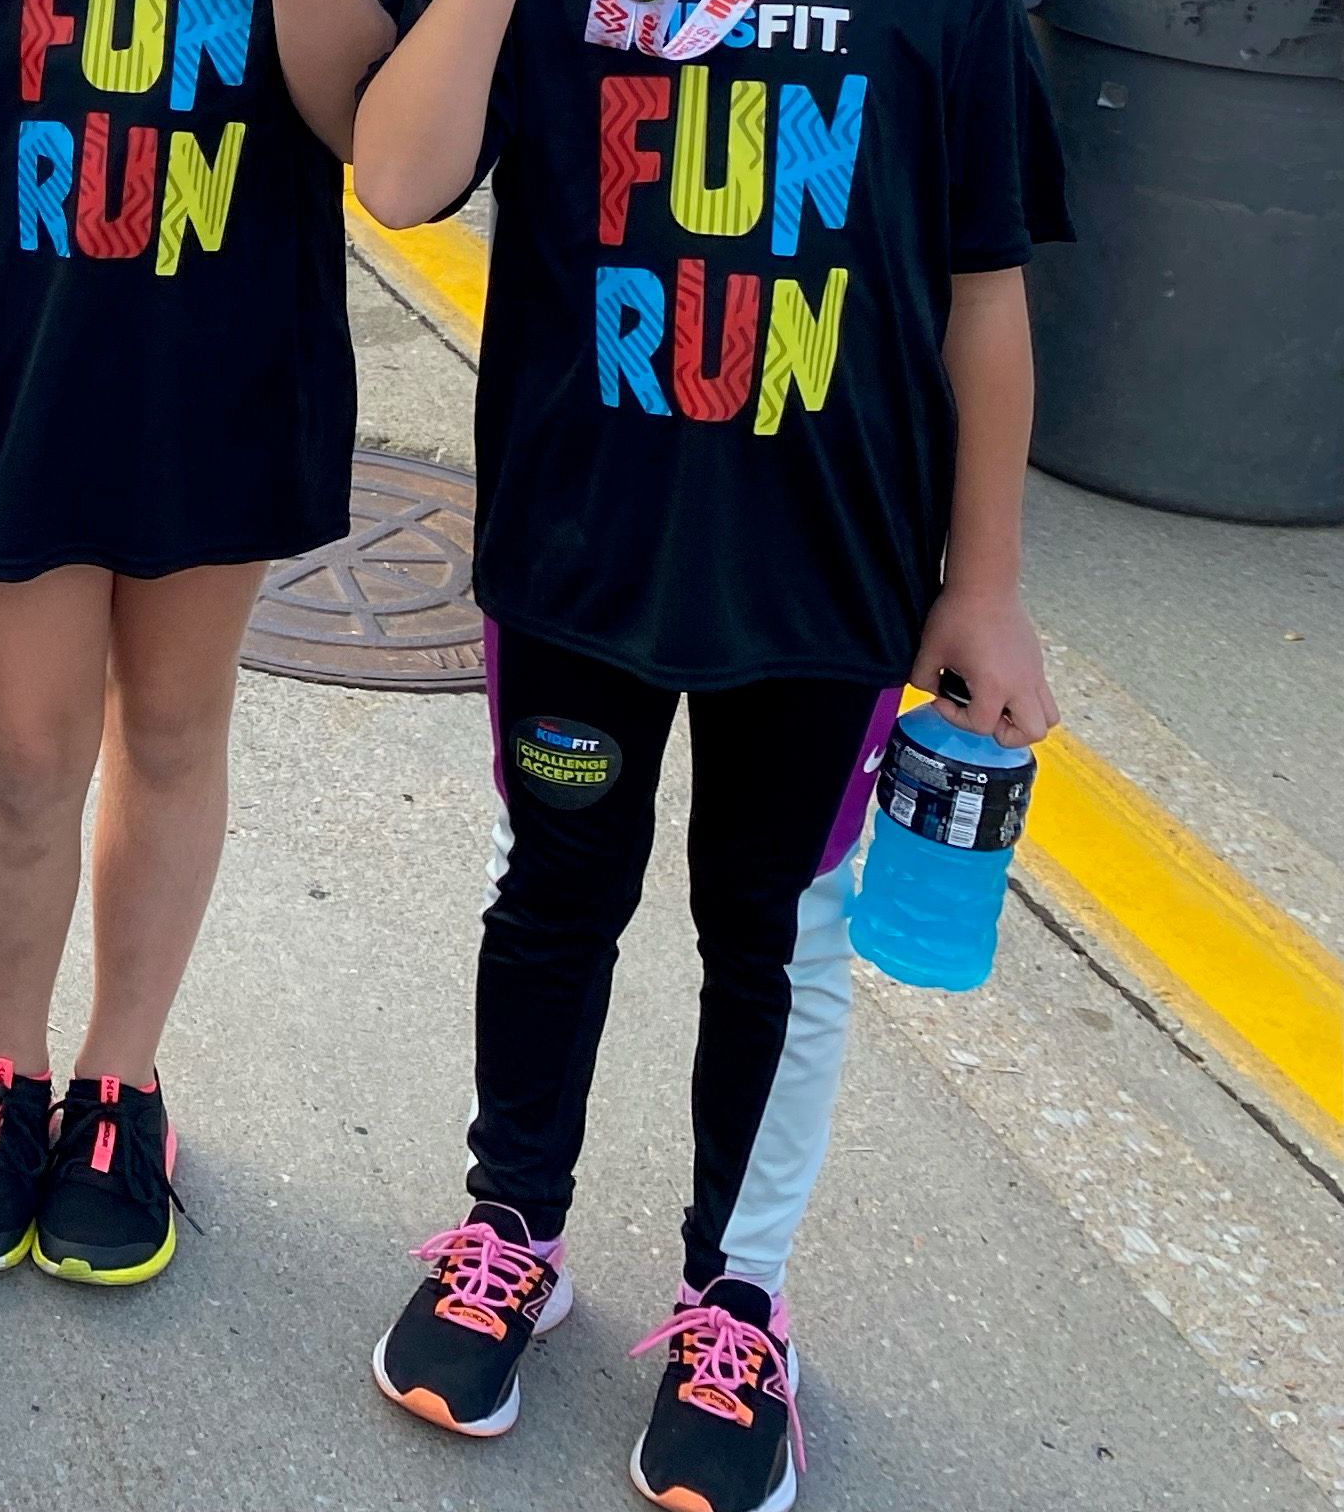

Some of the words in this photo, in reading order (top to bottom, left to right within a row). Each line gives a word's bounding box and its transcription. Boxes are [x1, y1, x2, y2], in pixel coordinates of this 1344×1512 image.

[18, 112, 246, 276] RUN
[599, 64, 868, 257] FUN
[595, 258, 849, 437] RUN
[521, 744, 608, 770] CHALLENGE
[522, 757, 607, 783] ACCEPTED
[536, 728, 600, 752] KIDSFIT
